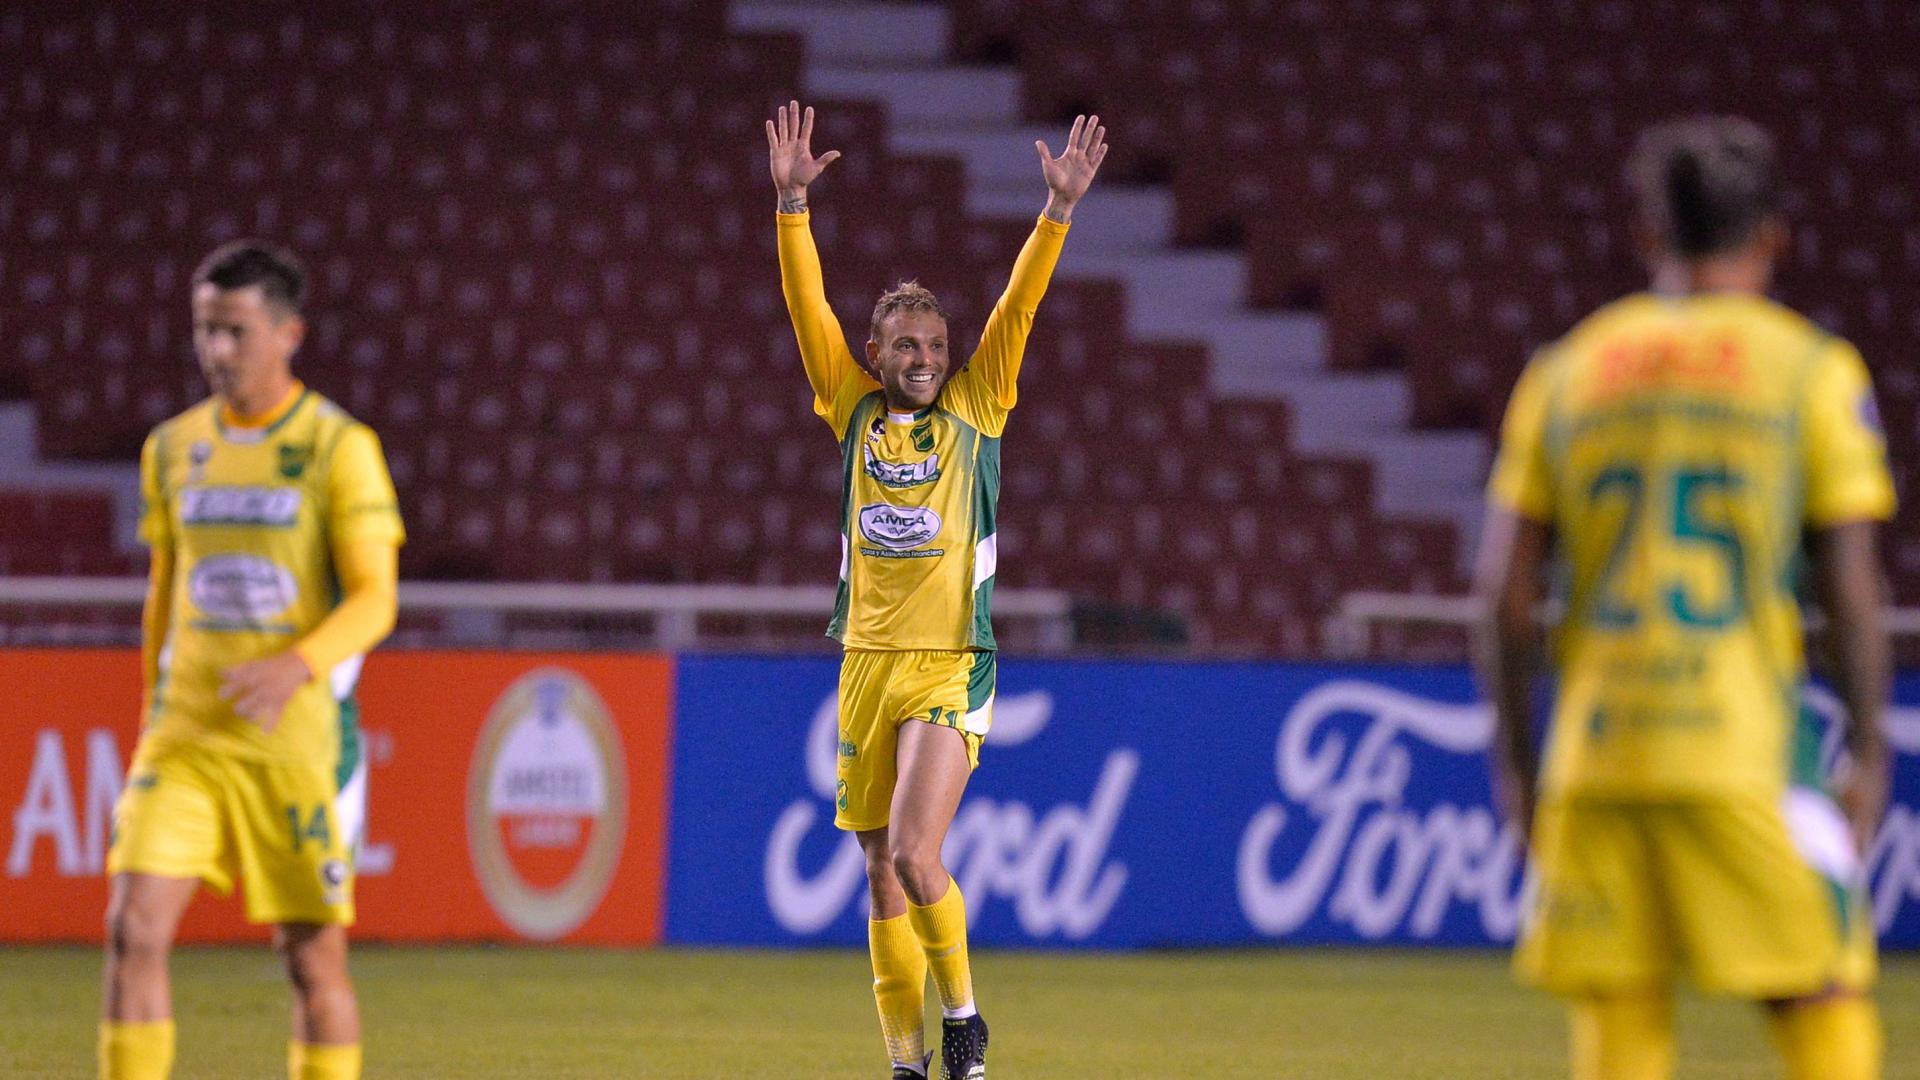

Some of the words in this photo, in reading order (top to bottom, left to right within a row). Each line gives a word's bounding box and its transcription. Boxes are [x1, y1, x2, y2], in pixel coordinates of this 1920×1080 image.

[871, 514, 927, 527] AMCA
[1590, 463, 1748, 632] 25
[287, 803, 330, 853] 14
[764, 686, 1140, 938] Frd
